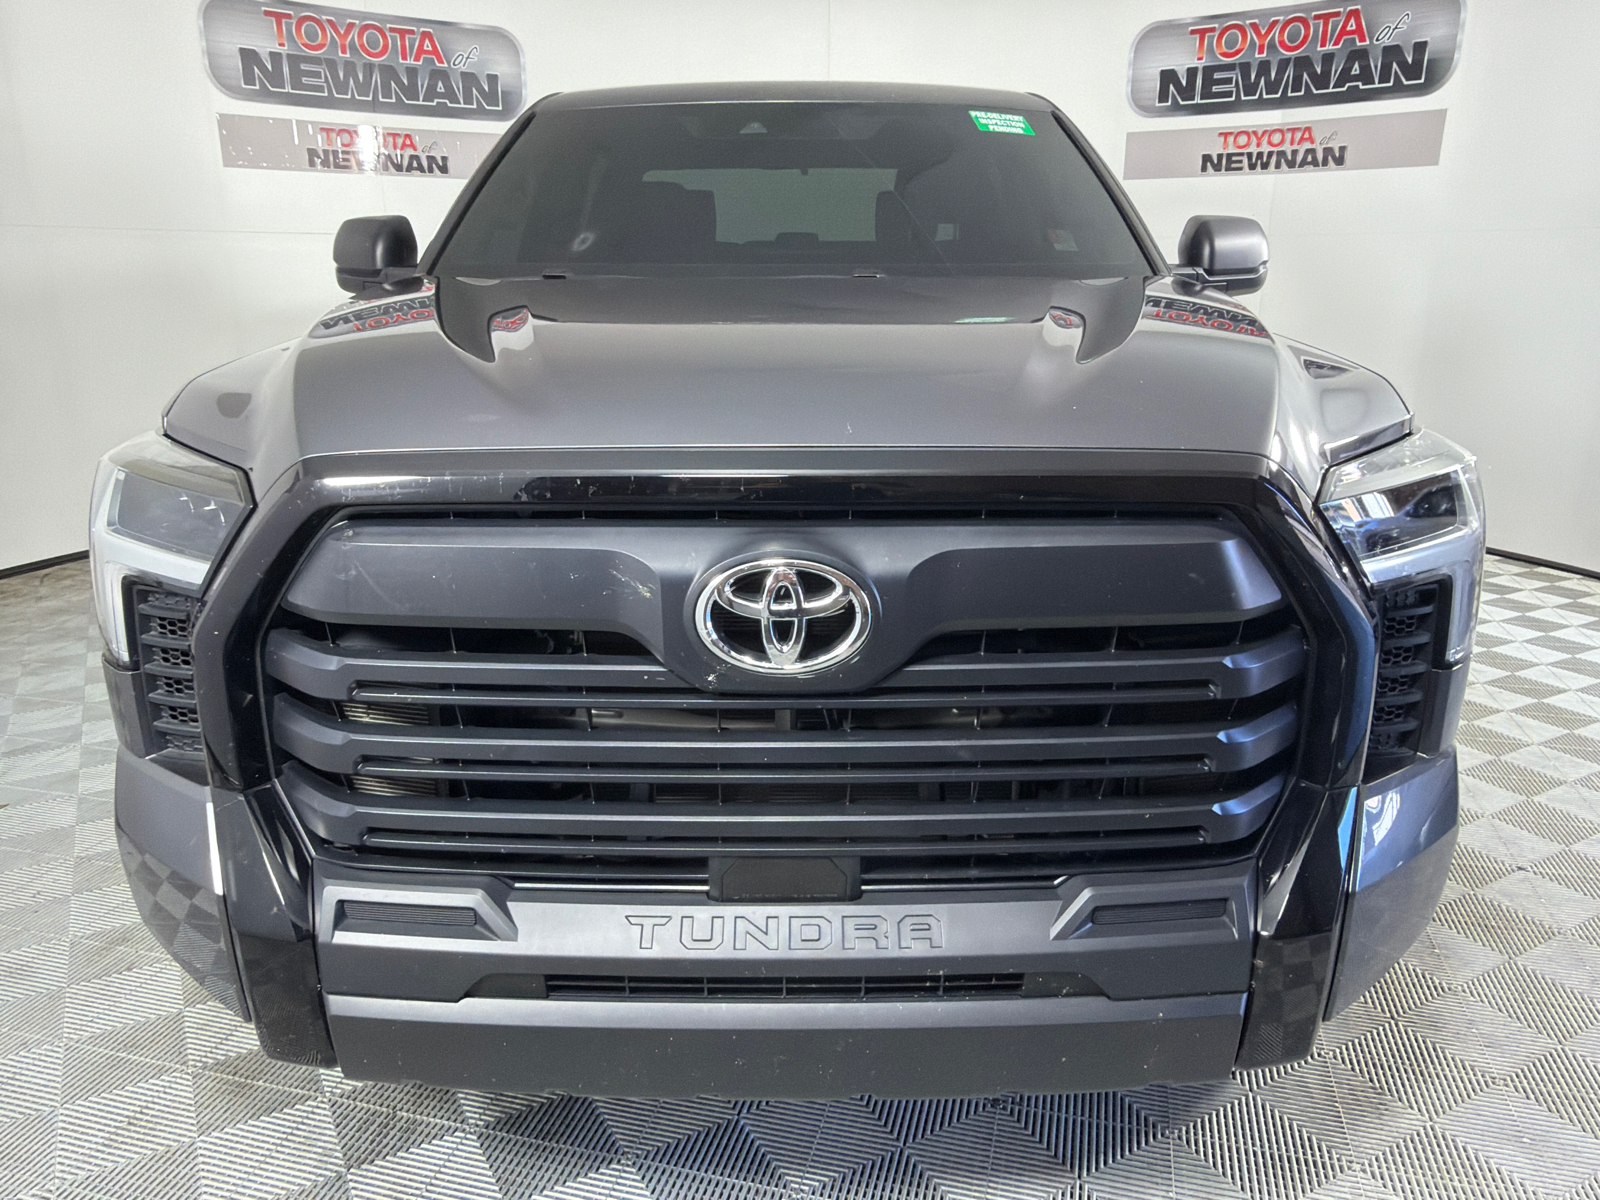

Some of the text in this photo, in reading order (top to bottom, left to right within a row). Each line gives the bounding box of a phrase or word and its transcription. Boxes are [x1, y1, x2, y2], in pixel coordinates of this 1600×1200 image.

[262, 8, 478, 68] TOYOTA of
[1189, 6, 1411, 62] TOYOTA of
[238, 47, 502, 110] NEWNAN
[1156, 40, 1429, 107] NEWNAN
[978, 118, 1025, 128] INSPECTION
[1218, 126, 1338, 151] TOYOTA of
[319, 127, 438, 154] TOTA of
[306, 147, 449, 175] NENAN
[1200, 145, 1348, 174] NEWNAN
[625, 914, 944, 951] TUNDRA
